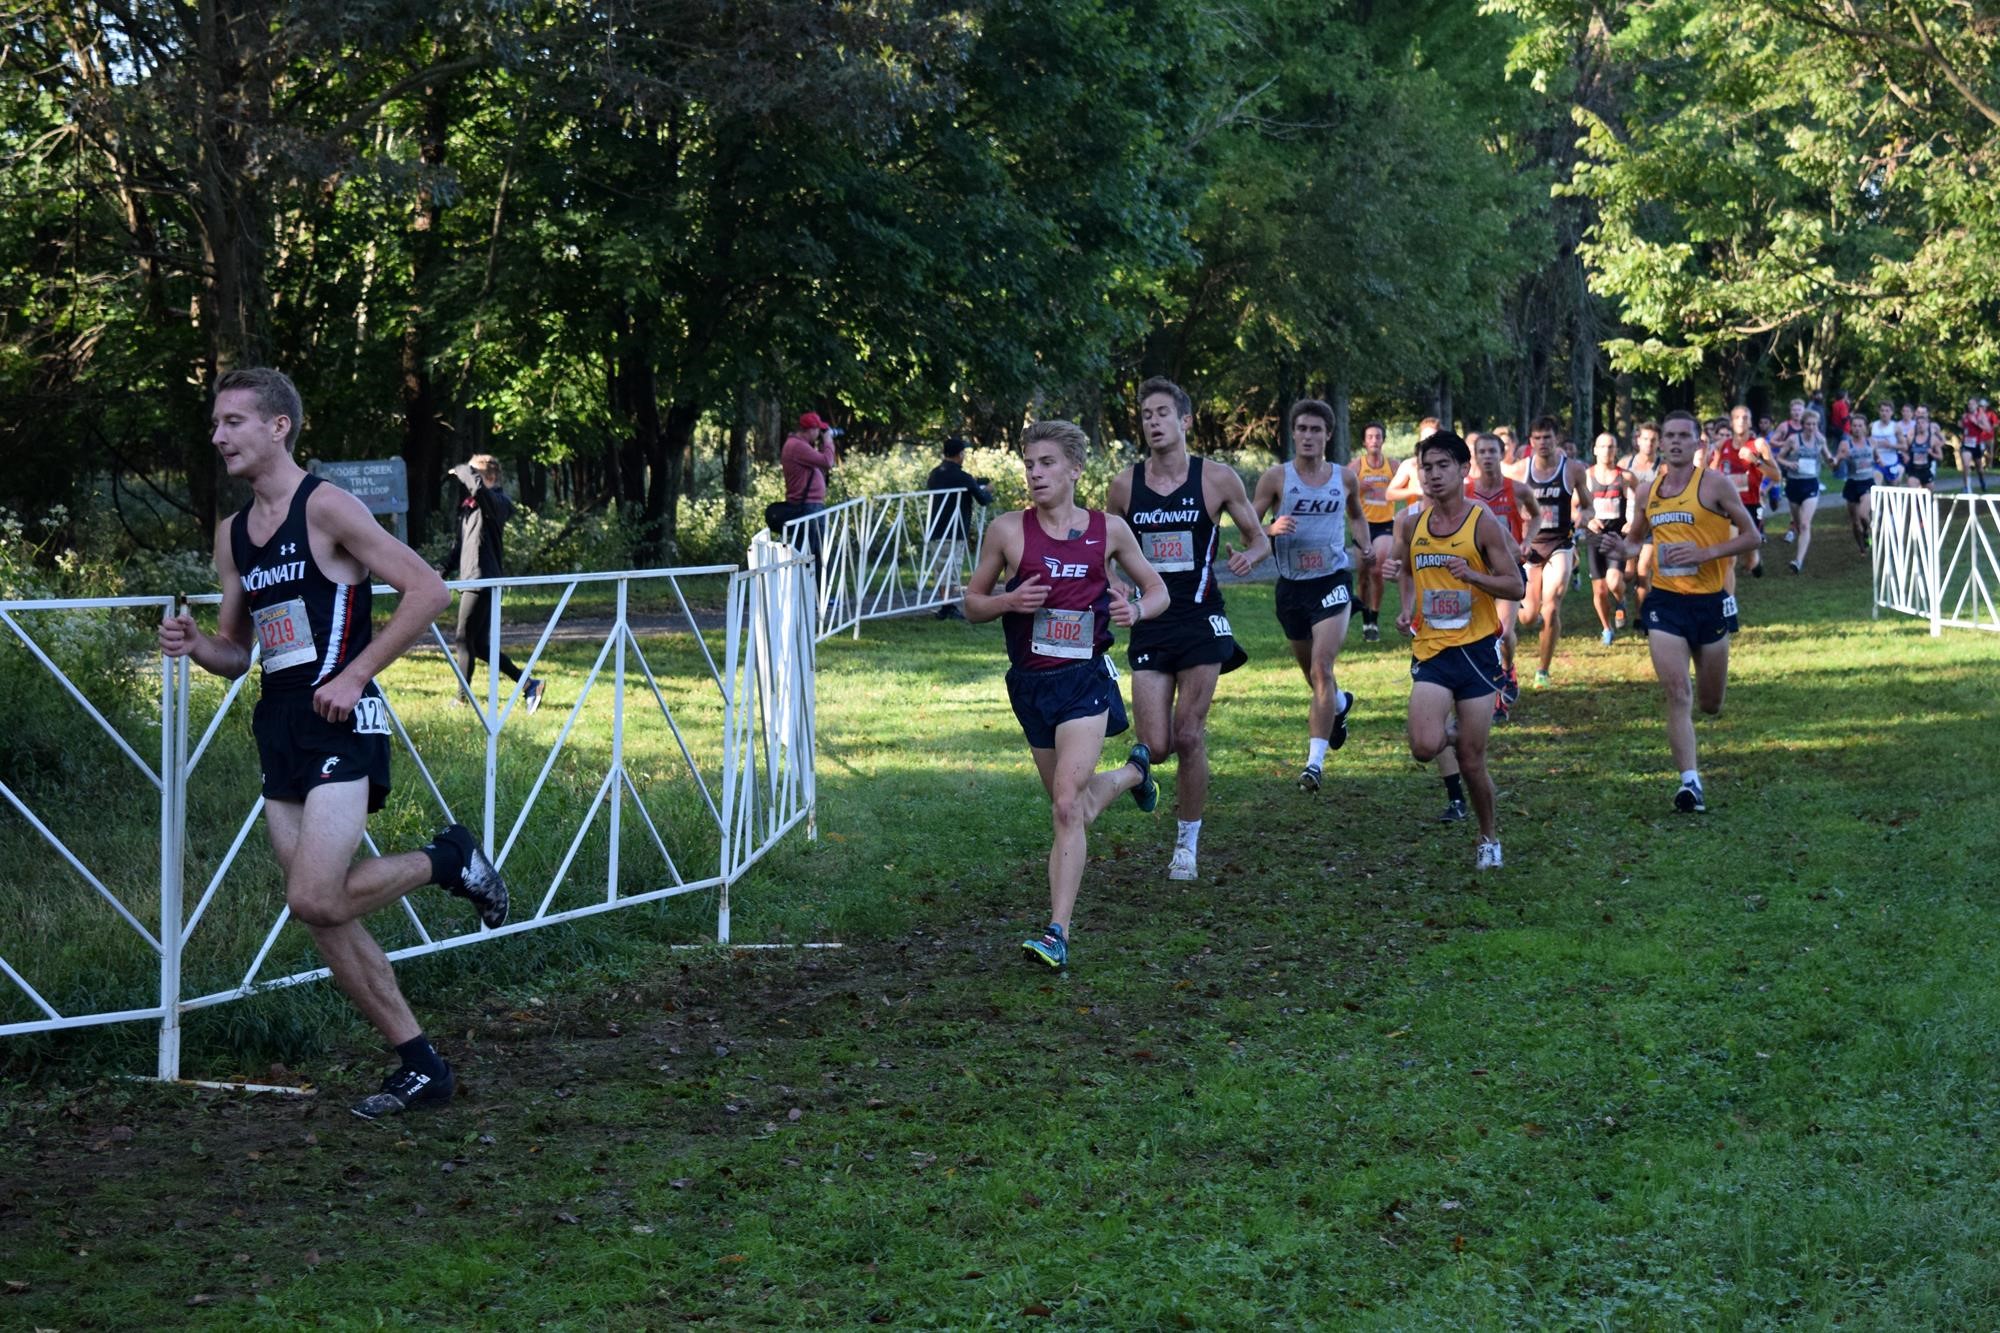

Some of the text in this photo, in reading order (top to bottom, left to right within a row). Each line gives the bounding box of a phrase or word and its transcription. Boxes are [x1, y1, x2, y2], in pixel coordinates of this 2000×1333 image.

[363, 465, 393, 476] CREEK
[350, 477, 376, 487] TRAIL
[370, 486, 390, 495] LOOP
[1293, 499, 1340, 513] EKU
[1133, 508, 1200, 524] CINCINNATI
[1151, 543, 1183, 558] 1223
[240, 560, 306, 592] NCINNATI
[1051, 564, 1089, 577] LEE
[1324, 586, 1348, 606] 1323
[1431, 600, 1460, 615] 1653
[261, 617, 295, 650] 1219
[1046, 619, 1082, 641] 1602
